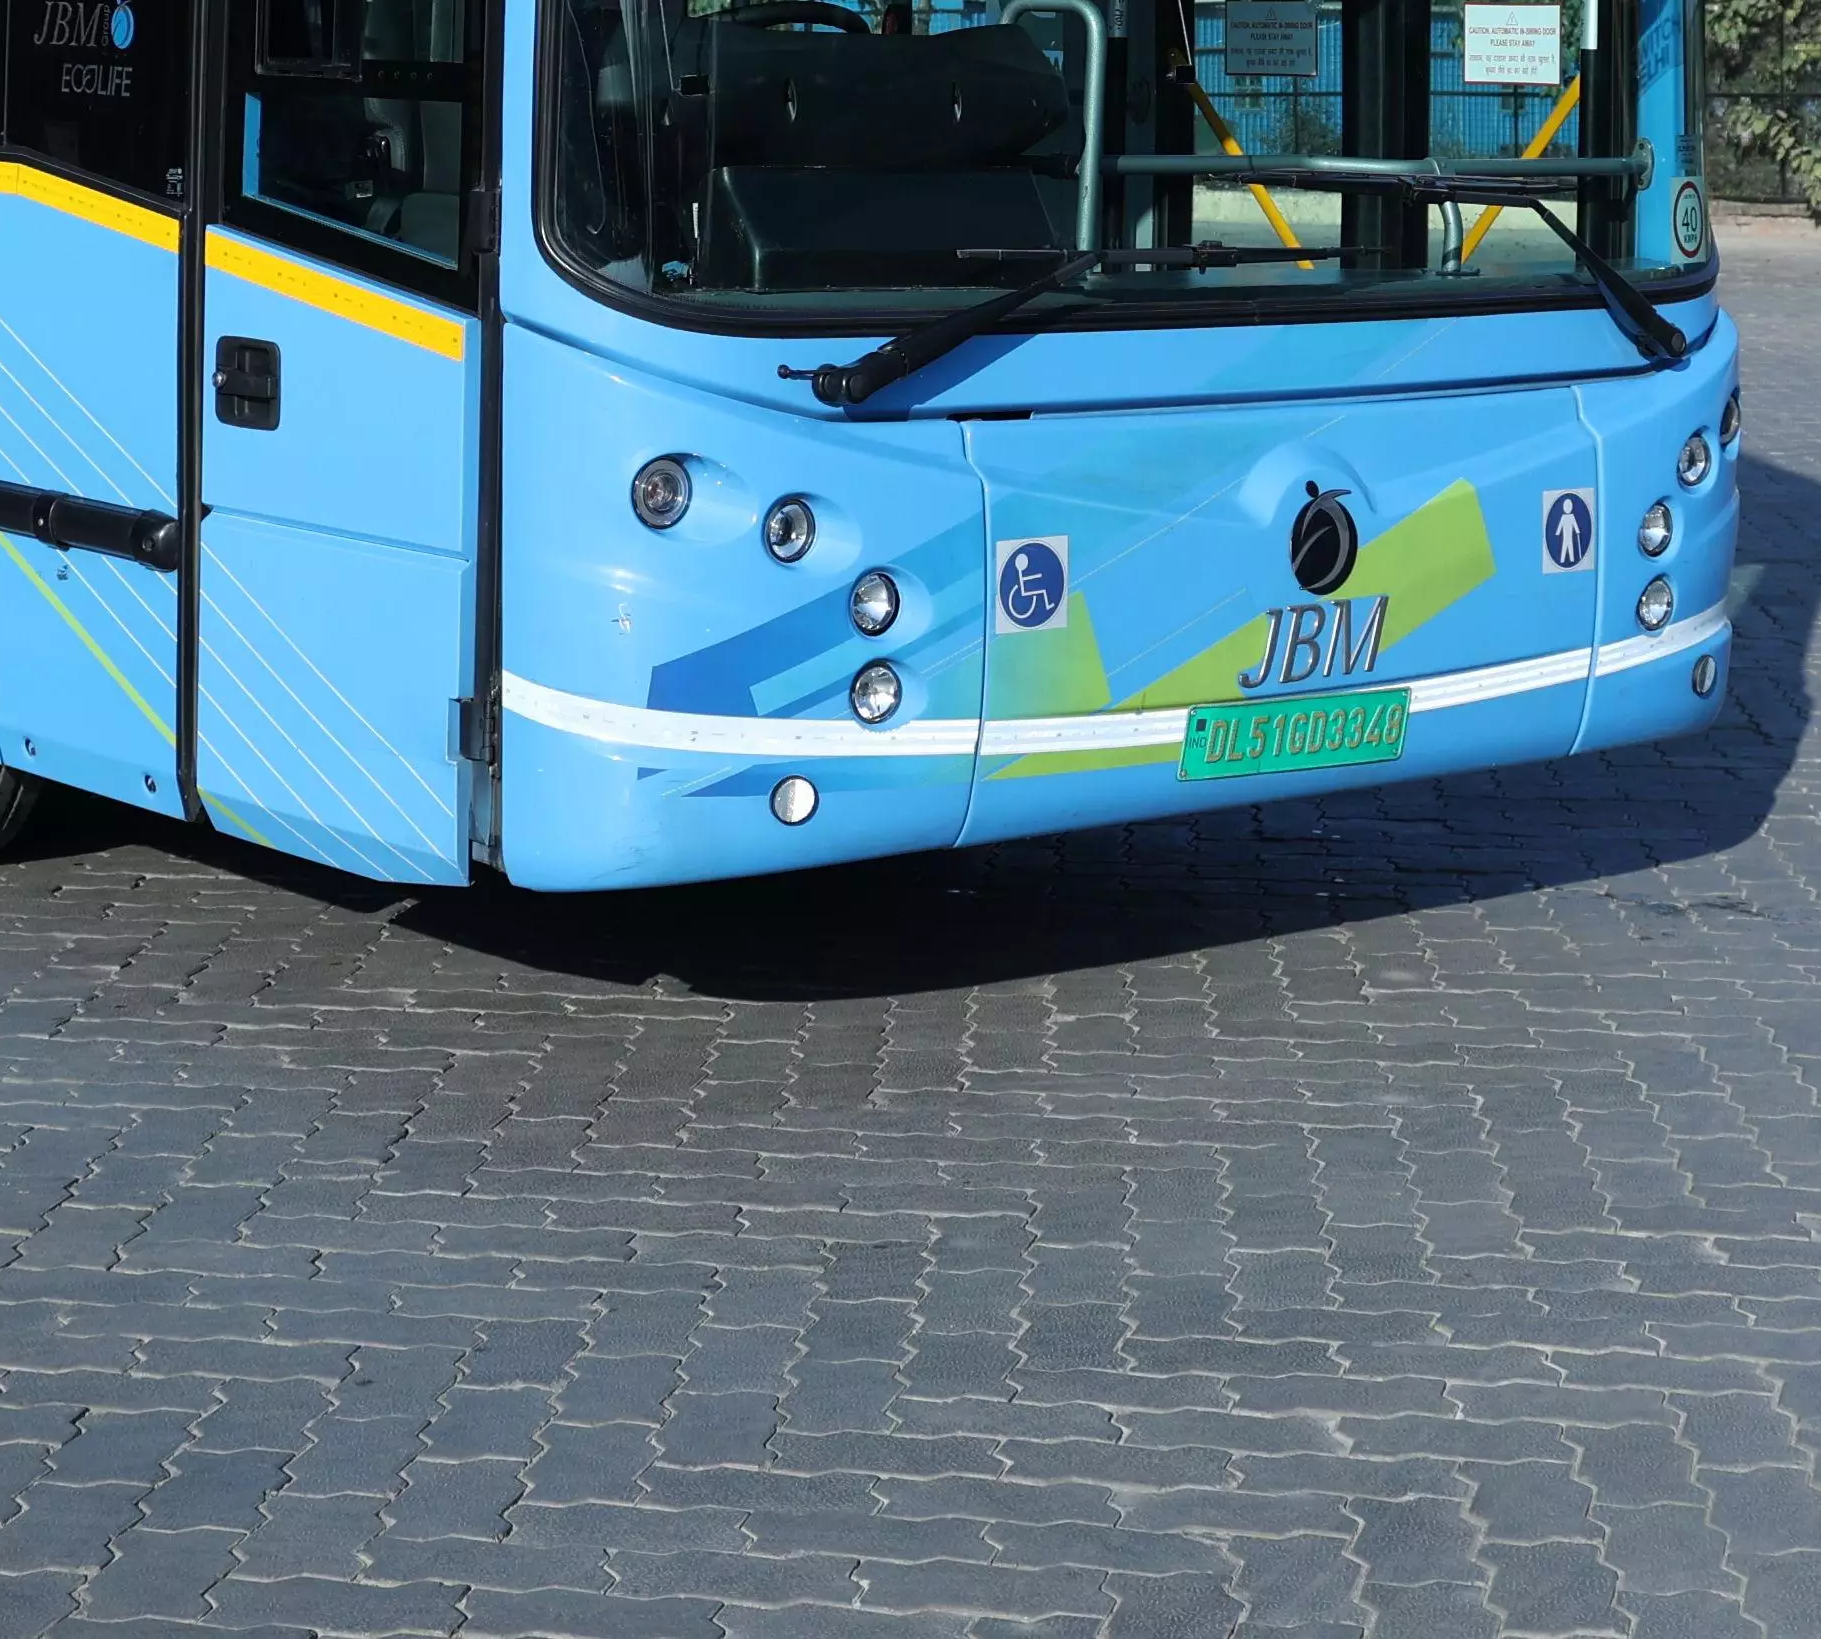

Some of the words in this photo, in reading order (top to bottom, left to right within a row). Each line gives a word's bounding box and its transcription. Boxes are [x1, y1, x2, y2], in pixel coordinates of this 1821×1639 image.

[34, 1, 103, 47] JBM
[1490, 38, 1508, 47] PLEASE
[61, 63, 133, 97] ECOLIFE
[1682, 206, 1698, 232] 40
[1238, 595, 1389, 688] JBM
[1205, 703, 1402, 763] DL51GD3348
